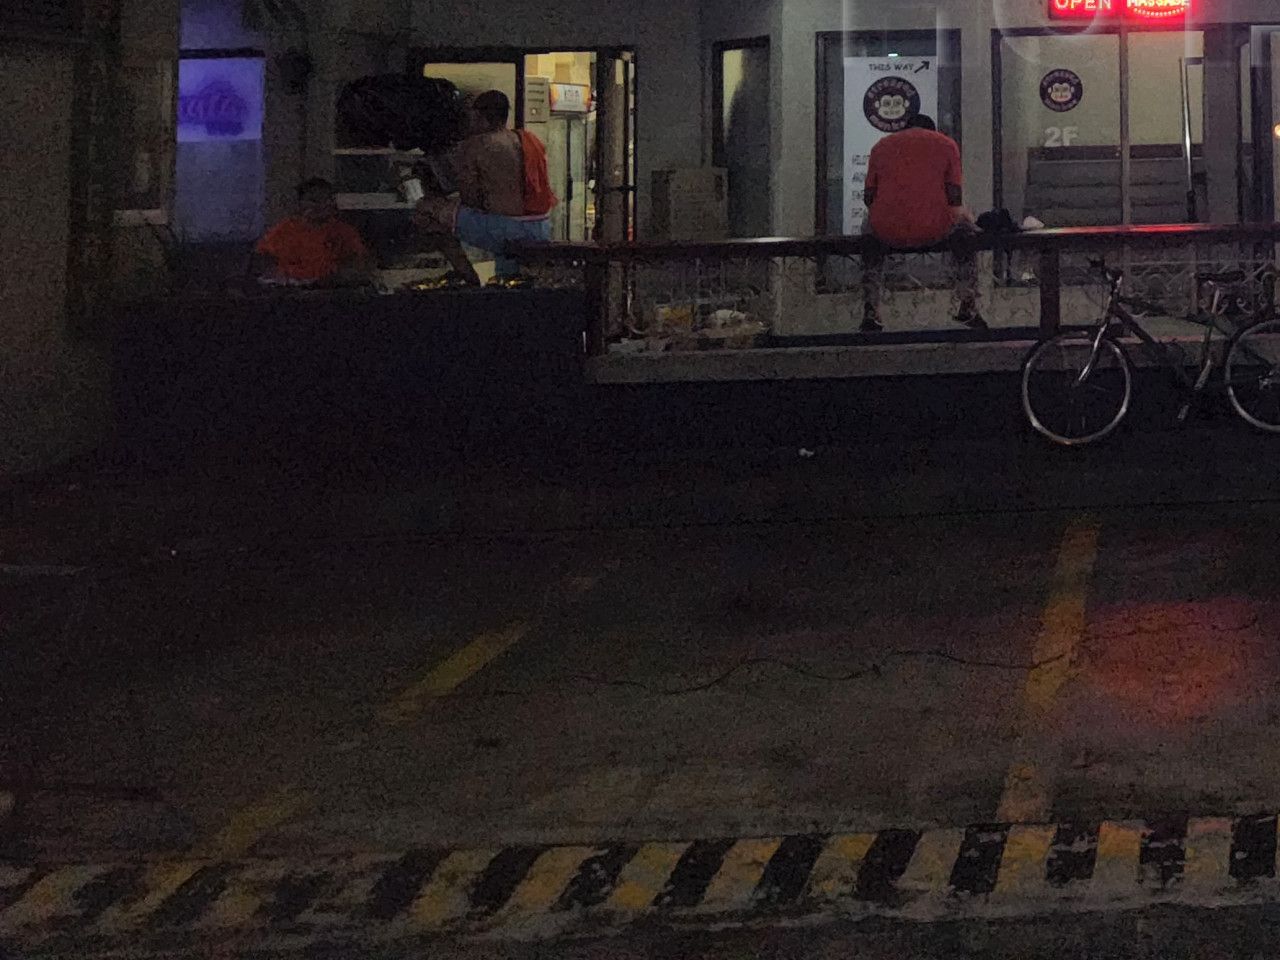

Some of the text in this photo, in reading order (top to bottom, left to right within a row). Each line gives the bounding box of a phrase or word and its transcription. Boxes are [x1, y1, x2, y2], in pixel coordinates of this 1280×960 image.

[868, 62, 914, 72] THIS WAY
[1043, 126, 1079, 148] 2F
